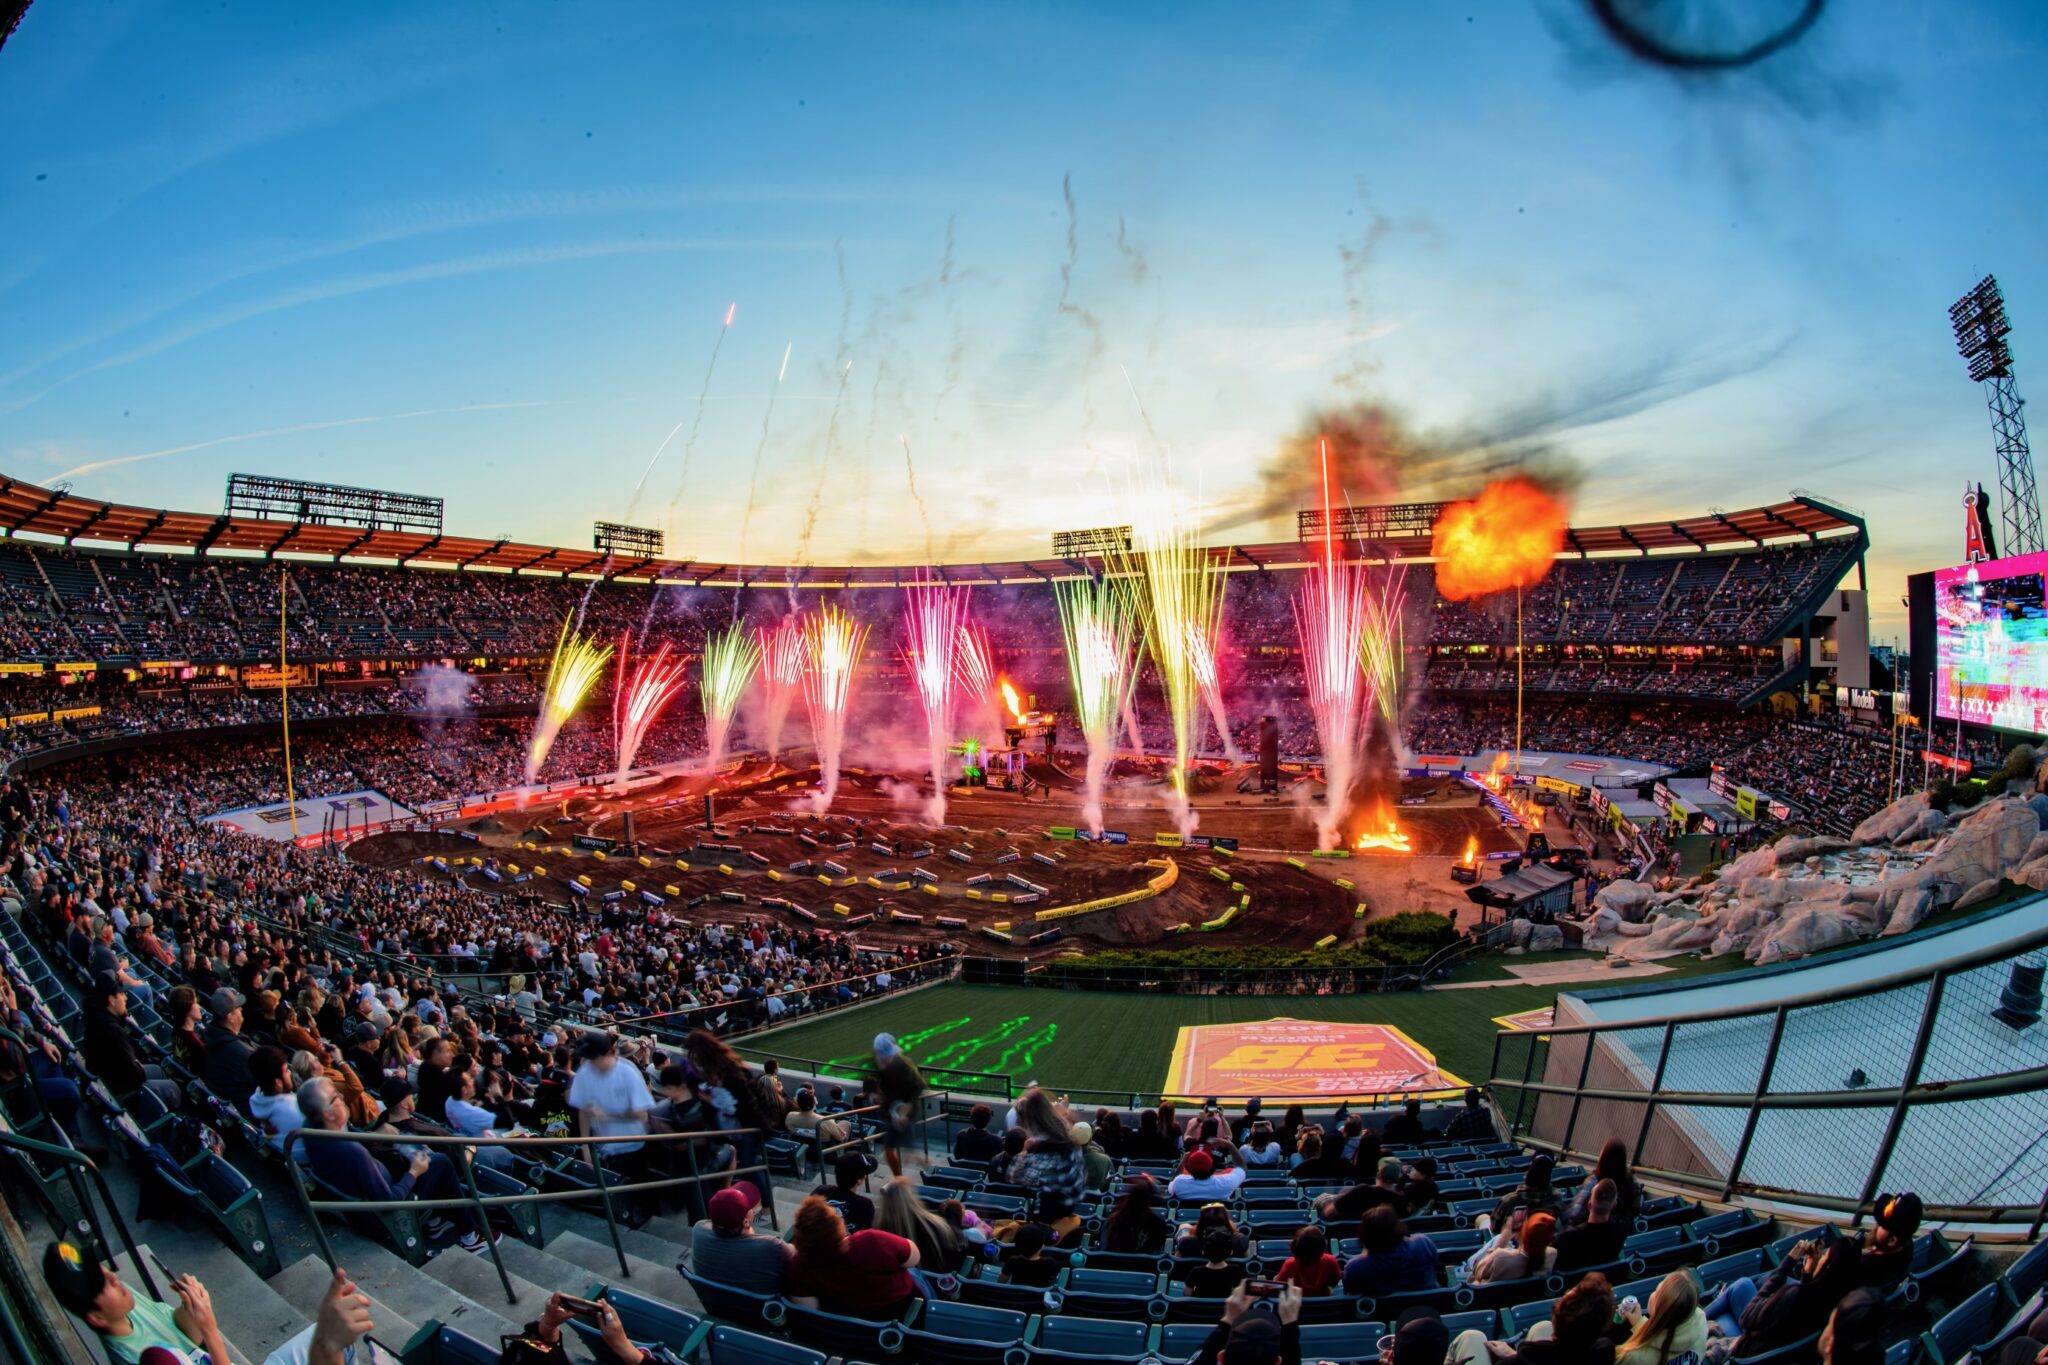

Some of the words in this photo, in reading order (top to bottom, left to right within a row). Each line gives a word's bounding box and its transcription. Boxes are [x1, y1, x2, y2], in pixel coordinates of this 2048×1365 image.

[1851, 688, 1875, 710] Modelo
[1025, 727, 1048, 738] FINISH
[1543, 780, 1564, 788] DUNLOP
[1045, 910, 1078, 919] DUNLOP
[1088, 901, 1118, 911] DUNLOP
[1208, 1043, 1386, 1070] 38
